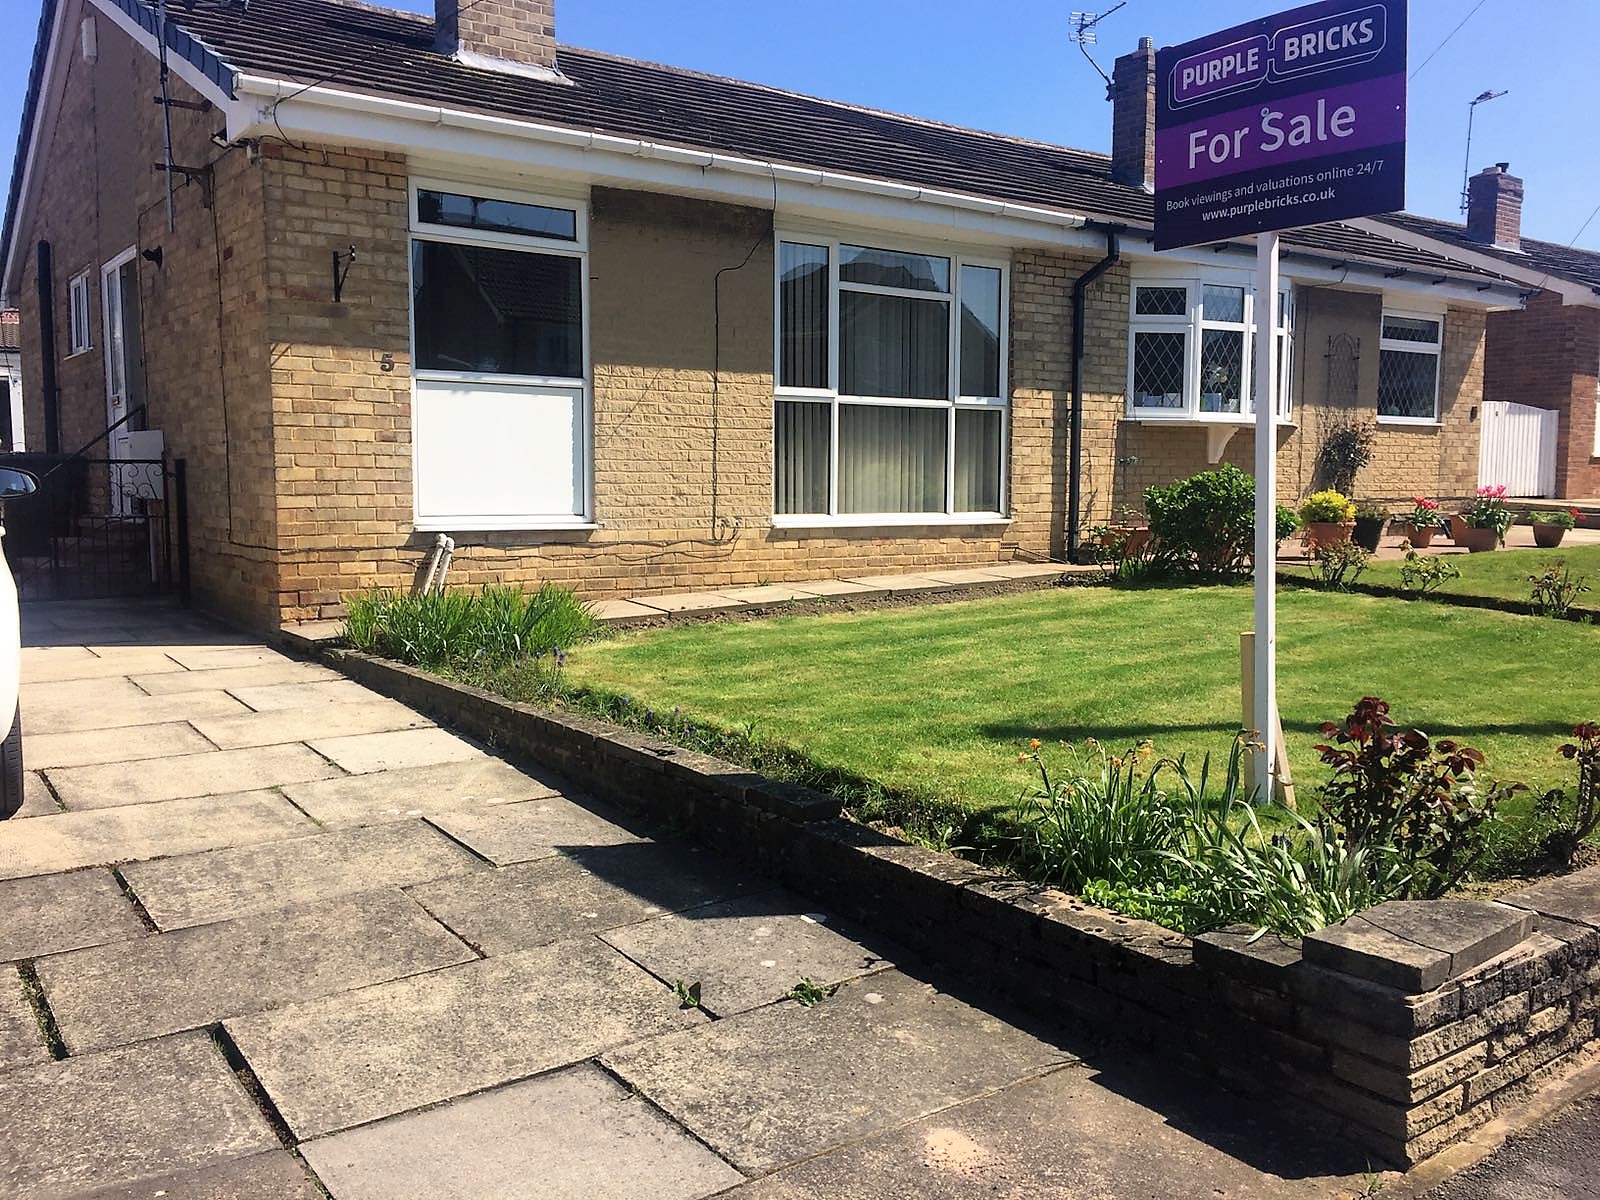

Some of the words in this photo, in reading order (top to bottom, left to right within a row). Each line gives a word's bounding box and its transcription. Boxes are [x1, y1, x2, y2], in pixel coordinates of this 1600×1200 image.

[1182, 47, 1259, 90] PURPLE
[1284, 18, 1374, 62] BRICKS
[1188, 127, 1250, 169] For
[1260, 99, 1356, 152] Sale
[1166, 197, 1190, 212] Book
[1191, 190, 1233, 203] viewings
[1234, 182, 1254, 197] and
[1256, 174, 1314, 193] valuations
[1316, 167, 1354, 182] online
[1357, 160, 1384, 175] 24/7
[1202, 187, 1336, 221] www.purplebricks.co.uk
[380, 352, 395, 373] 5
